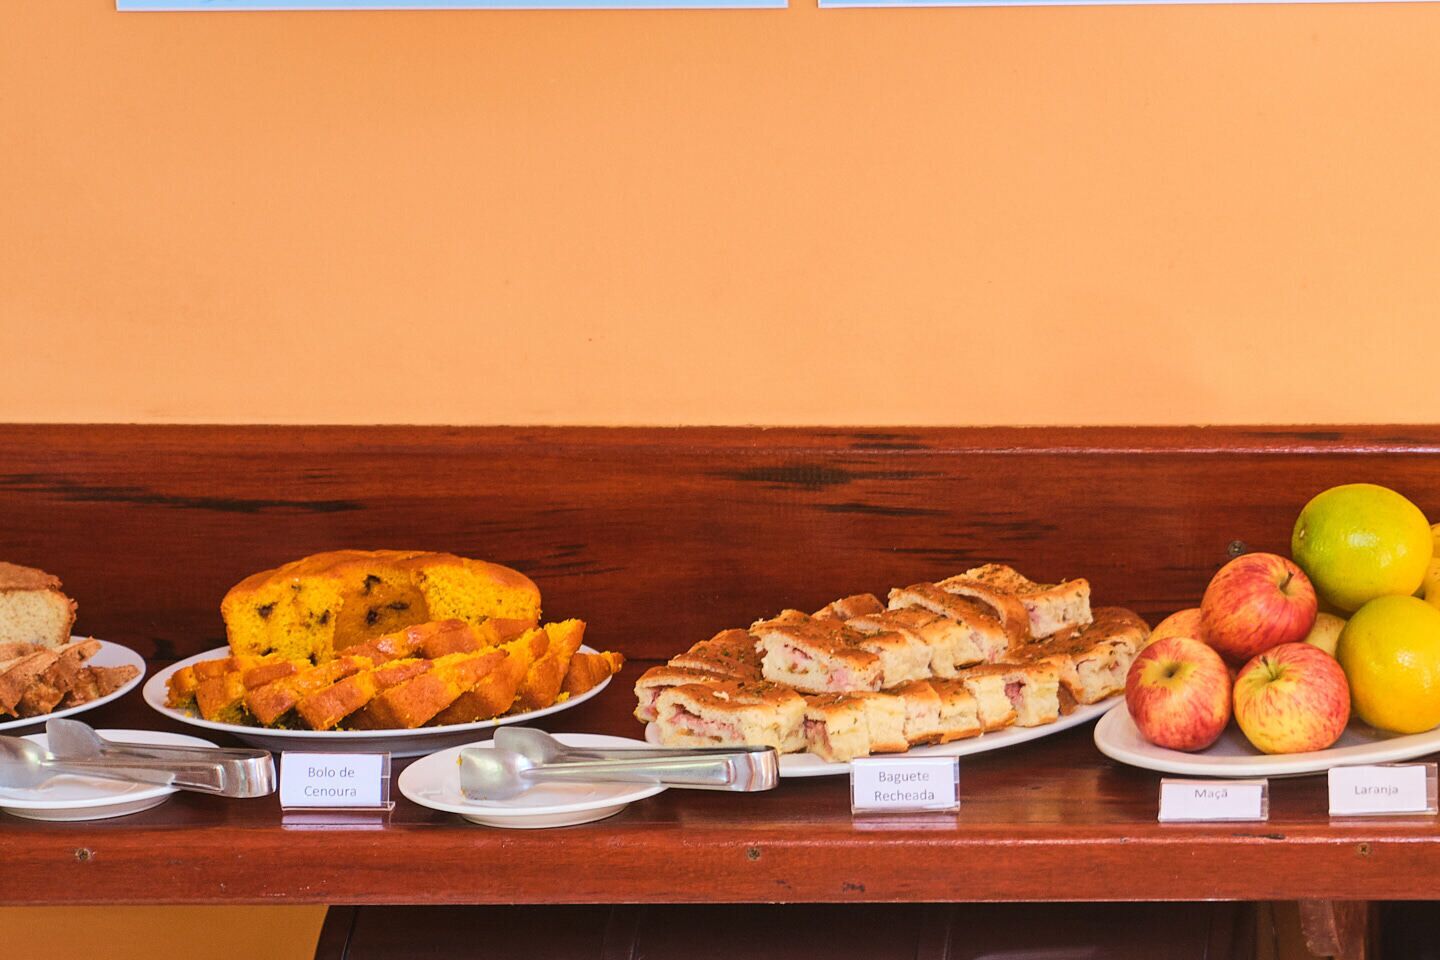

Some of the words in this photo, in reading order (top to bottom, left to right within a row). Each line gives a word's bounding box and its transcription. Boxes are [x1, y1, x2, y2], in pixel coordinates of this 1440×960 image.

[308, 766, 336, 778] Bolo
[340, 766, 355, 778] de
[878, 771, 929, 786] Baguete
[304, 785, 357, 797] Cenoura
[874, 789, 935, 802] Recheada
[1194, 788, 1228, 800] Maçã
[1354, 785, 1399, 798] Laranja
